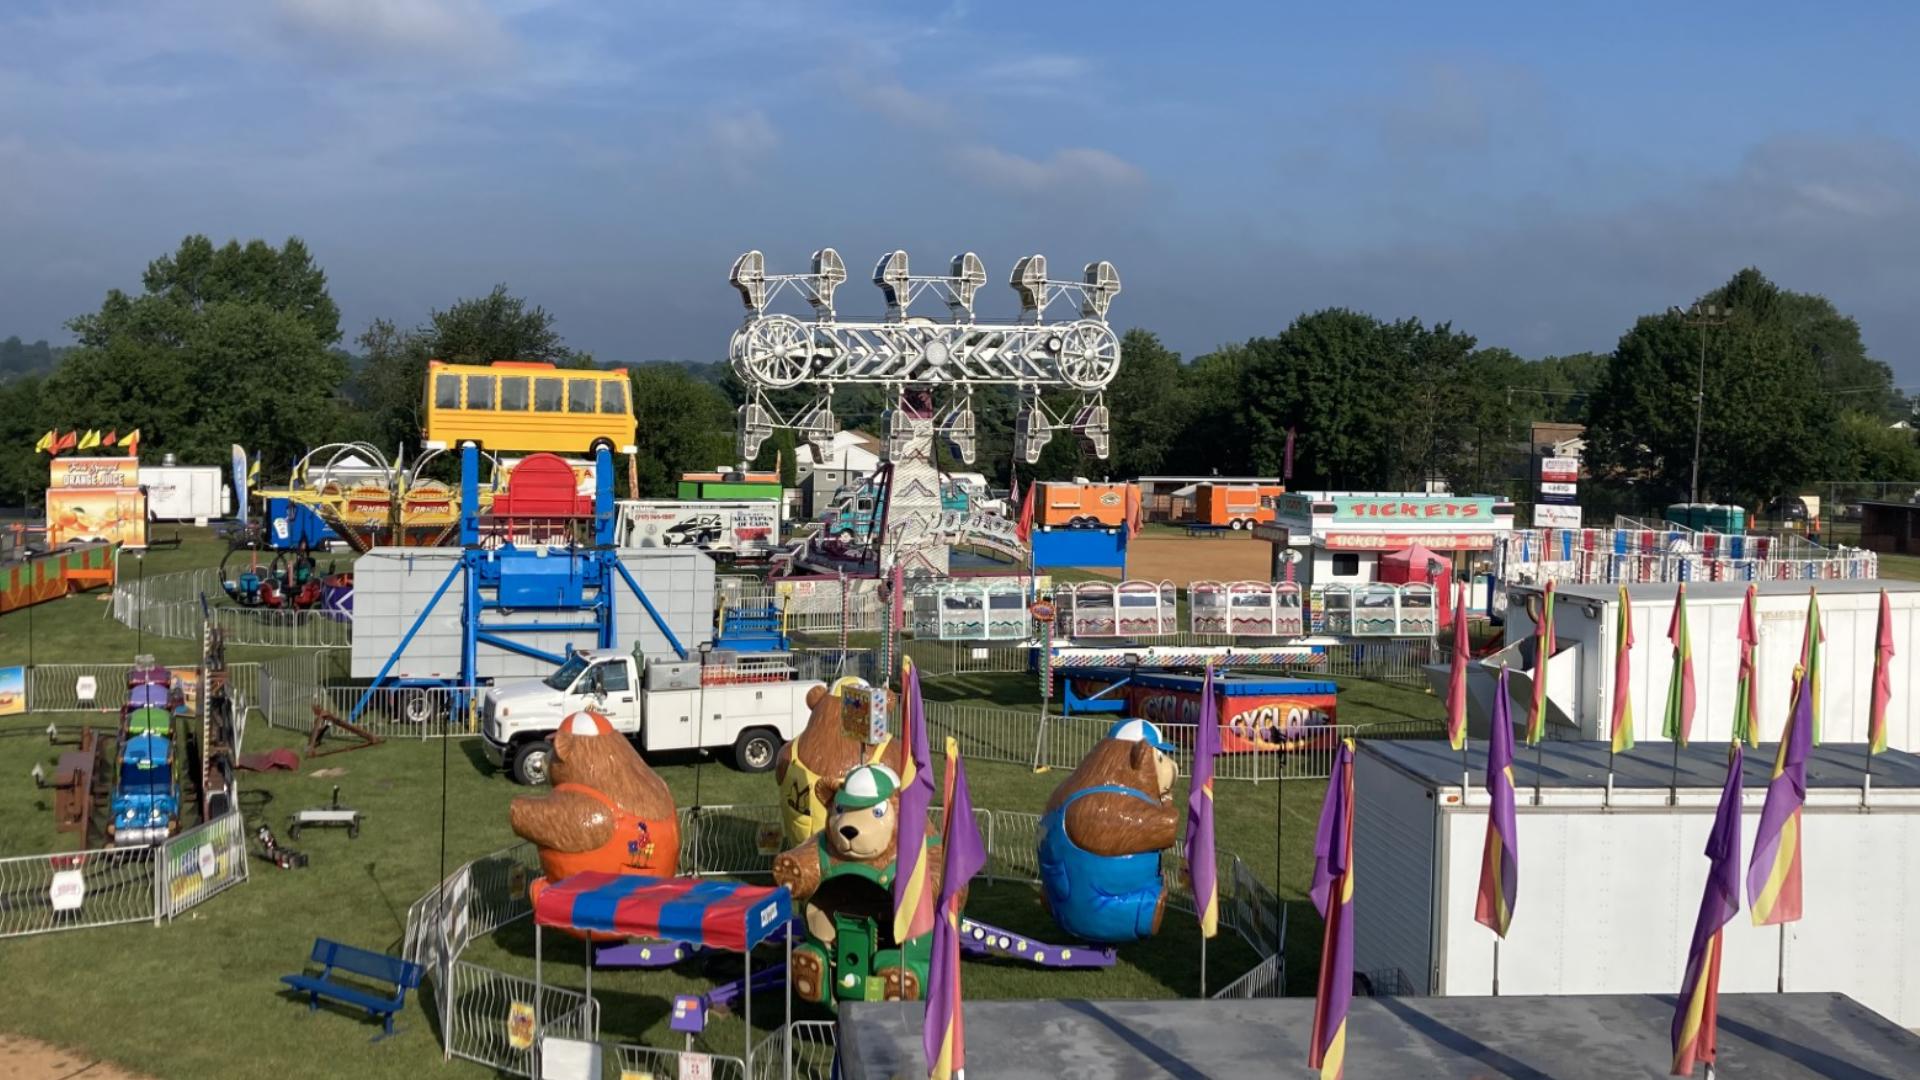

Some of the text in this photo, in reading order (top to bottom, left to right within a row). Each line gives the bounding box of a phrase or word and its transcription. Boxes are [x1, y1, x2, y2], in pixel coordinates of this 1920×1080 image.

[63, 473, 124, 487] ORANGE JUICE
[1351, 502, 1479, 518] TICKETS
[1335, 534, 1387, 548] TICKETS
[1146, 695, 1200, 723] CYCLON
[1229, 706, 1331, 742] CYCLONE
